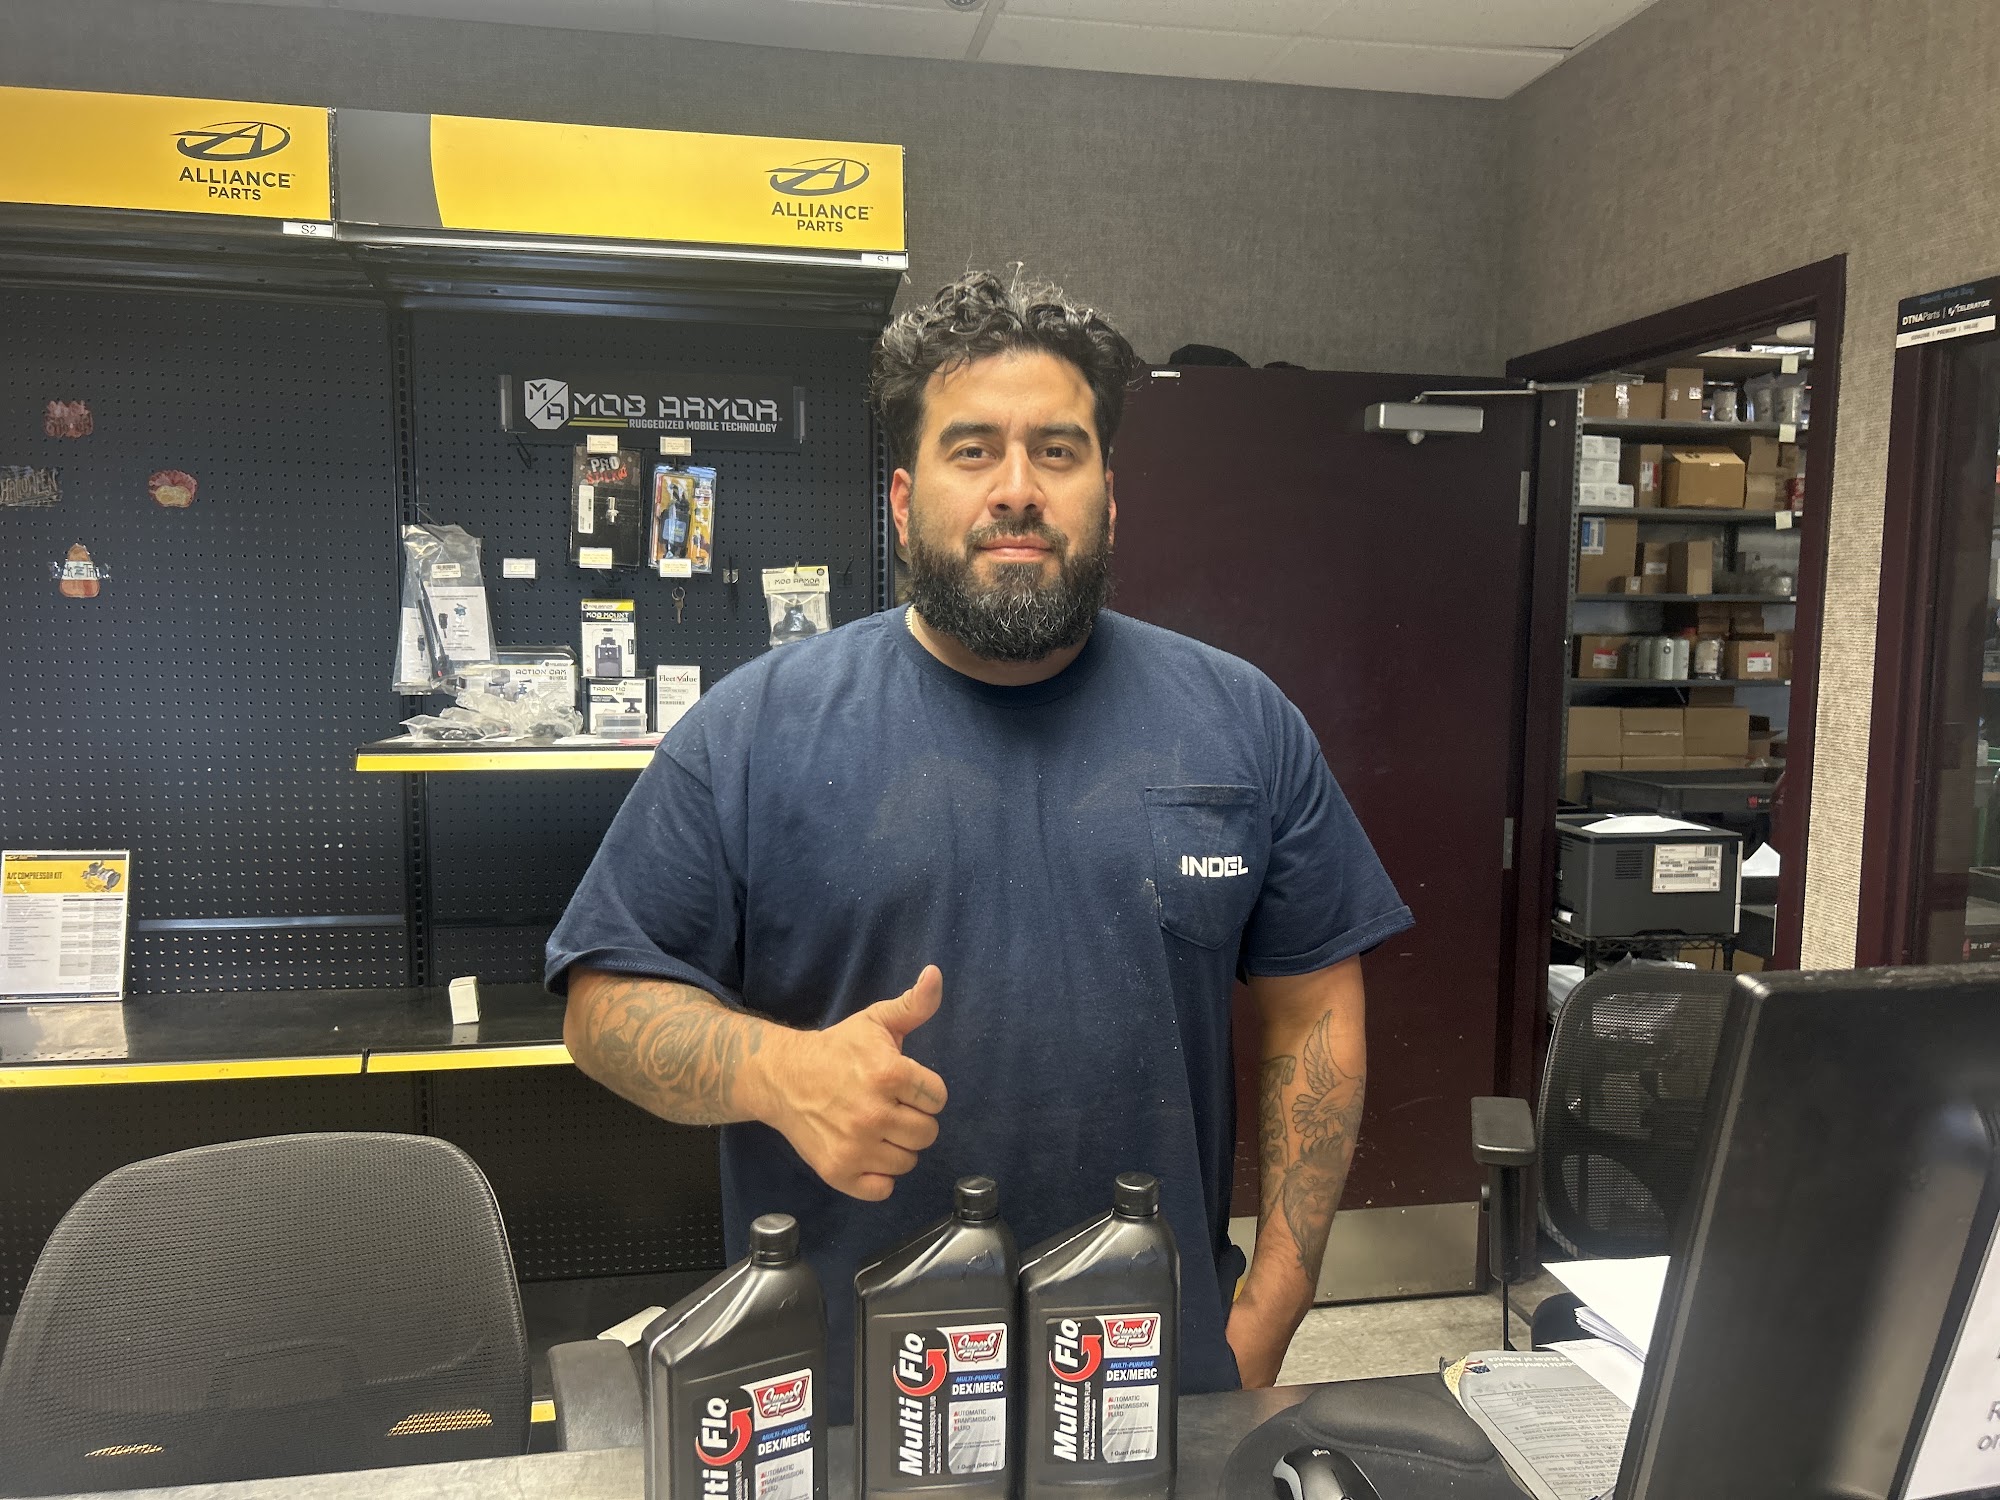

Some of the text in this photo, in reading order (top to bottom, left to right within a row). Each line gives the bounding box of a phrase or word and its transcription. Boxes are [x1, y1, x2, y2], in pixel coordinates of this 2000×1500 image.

[178, 167, 292, 189] ALLIANCE
[208, 186, 262, 201] PARTS
[771, 201, 870, 221] ALLIANCE
[300, 223, 317, 235] S2
[797, 219, 844, 233] PARTS
[877, 255, 890, 265] S1
[573, 393, 779, 422] MOB ARMOR
[629, 418, 778, 433] RUGGEDIZED MOBILE TECHNOLOGY
[18, 872, 54, 880] COMPRESSOR
[54, 871, 63, 879] KIT
[1110, 1360, 1154, 1369] MULTI-PURPOSE
[955, 1373, 1001, 1382] MULTI-PURPOSE
[1106, 1367, 1158, 1382] DEX/MERC
[952, 1381, 1004, 1396] DEX/MERC
[1053, 1318, 1079, 1462] Multi Flo
[898, 1332, 924, 1477] Multi Flo
[1108, 1395, 1140, 1403] AUTOMATIC
[1108, 1402, 1149, 1410] TRANSMISSION
[954, 1409, 986, 1417] AUTOMATIC
[954, 1416, 996, 1424] TRANSMISSION
[762, 1423, 808, 1441] MULTI-PURPOSE
[701, 1397, 729, 1500] lti Flo
[758, 1430, 811, 1456] DEX/MERC
